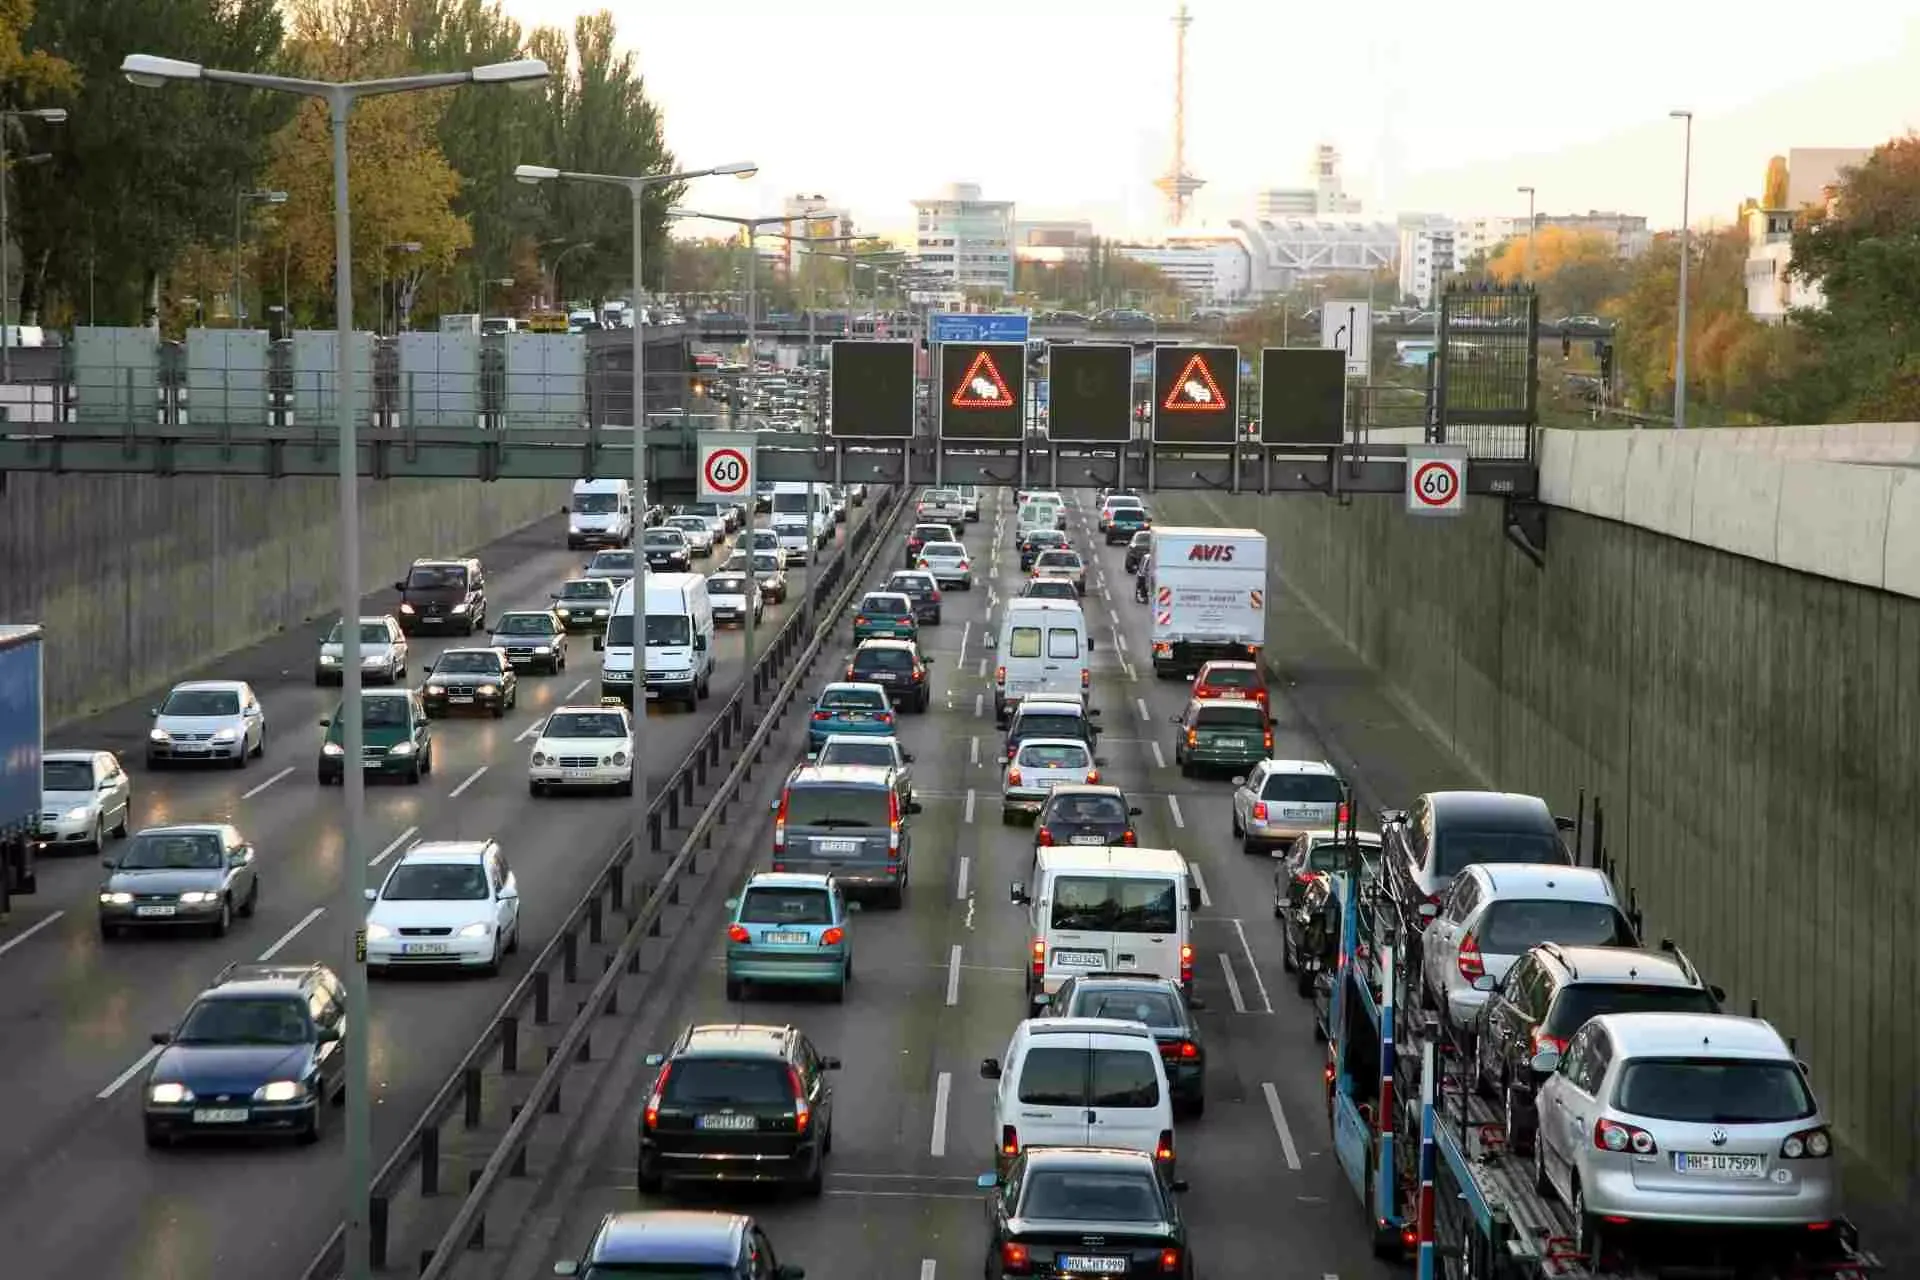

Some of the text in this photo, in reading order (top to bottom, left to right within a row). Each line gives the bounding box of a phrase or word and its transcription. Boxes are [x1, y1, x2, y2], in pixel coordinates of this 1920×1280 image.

[715, 461, 739, 481] 60
[1423, 473, 1449, 494] 60
[1188, 544, 1235, 562] AVIS
